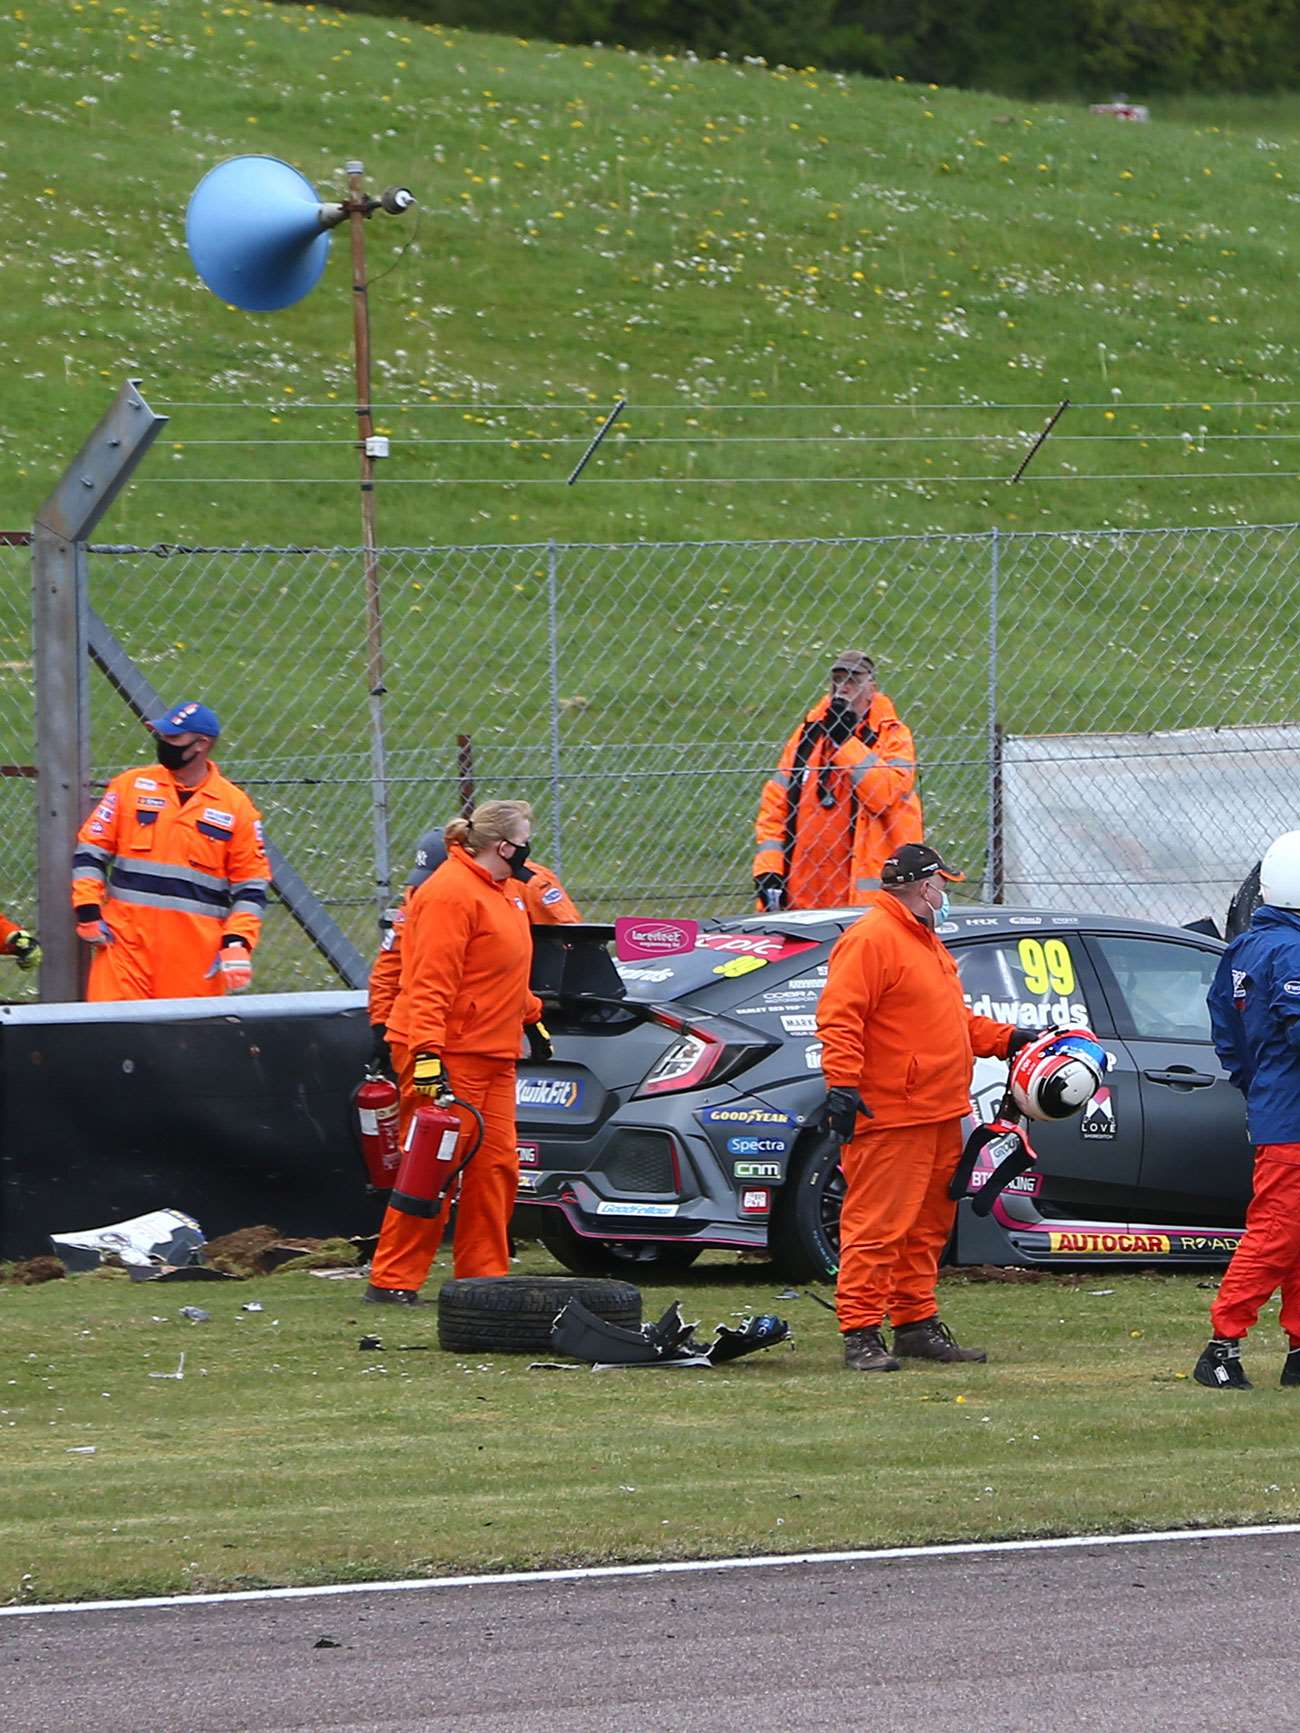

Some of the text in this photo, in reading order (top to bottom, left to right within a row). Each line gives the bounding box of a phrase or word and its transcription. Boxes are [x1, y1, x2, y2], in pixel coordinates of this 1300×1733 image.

[1018, 938, 1075, 996] 99
[711, 1110, 788, 1123] GOODYEAR
[1081, 1122, 1117, 1133] LOVE
[732, 1138, 785, 1152] Spectra
[1057, 1233, 1164, 1253] AUTOCAR
